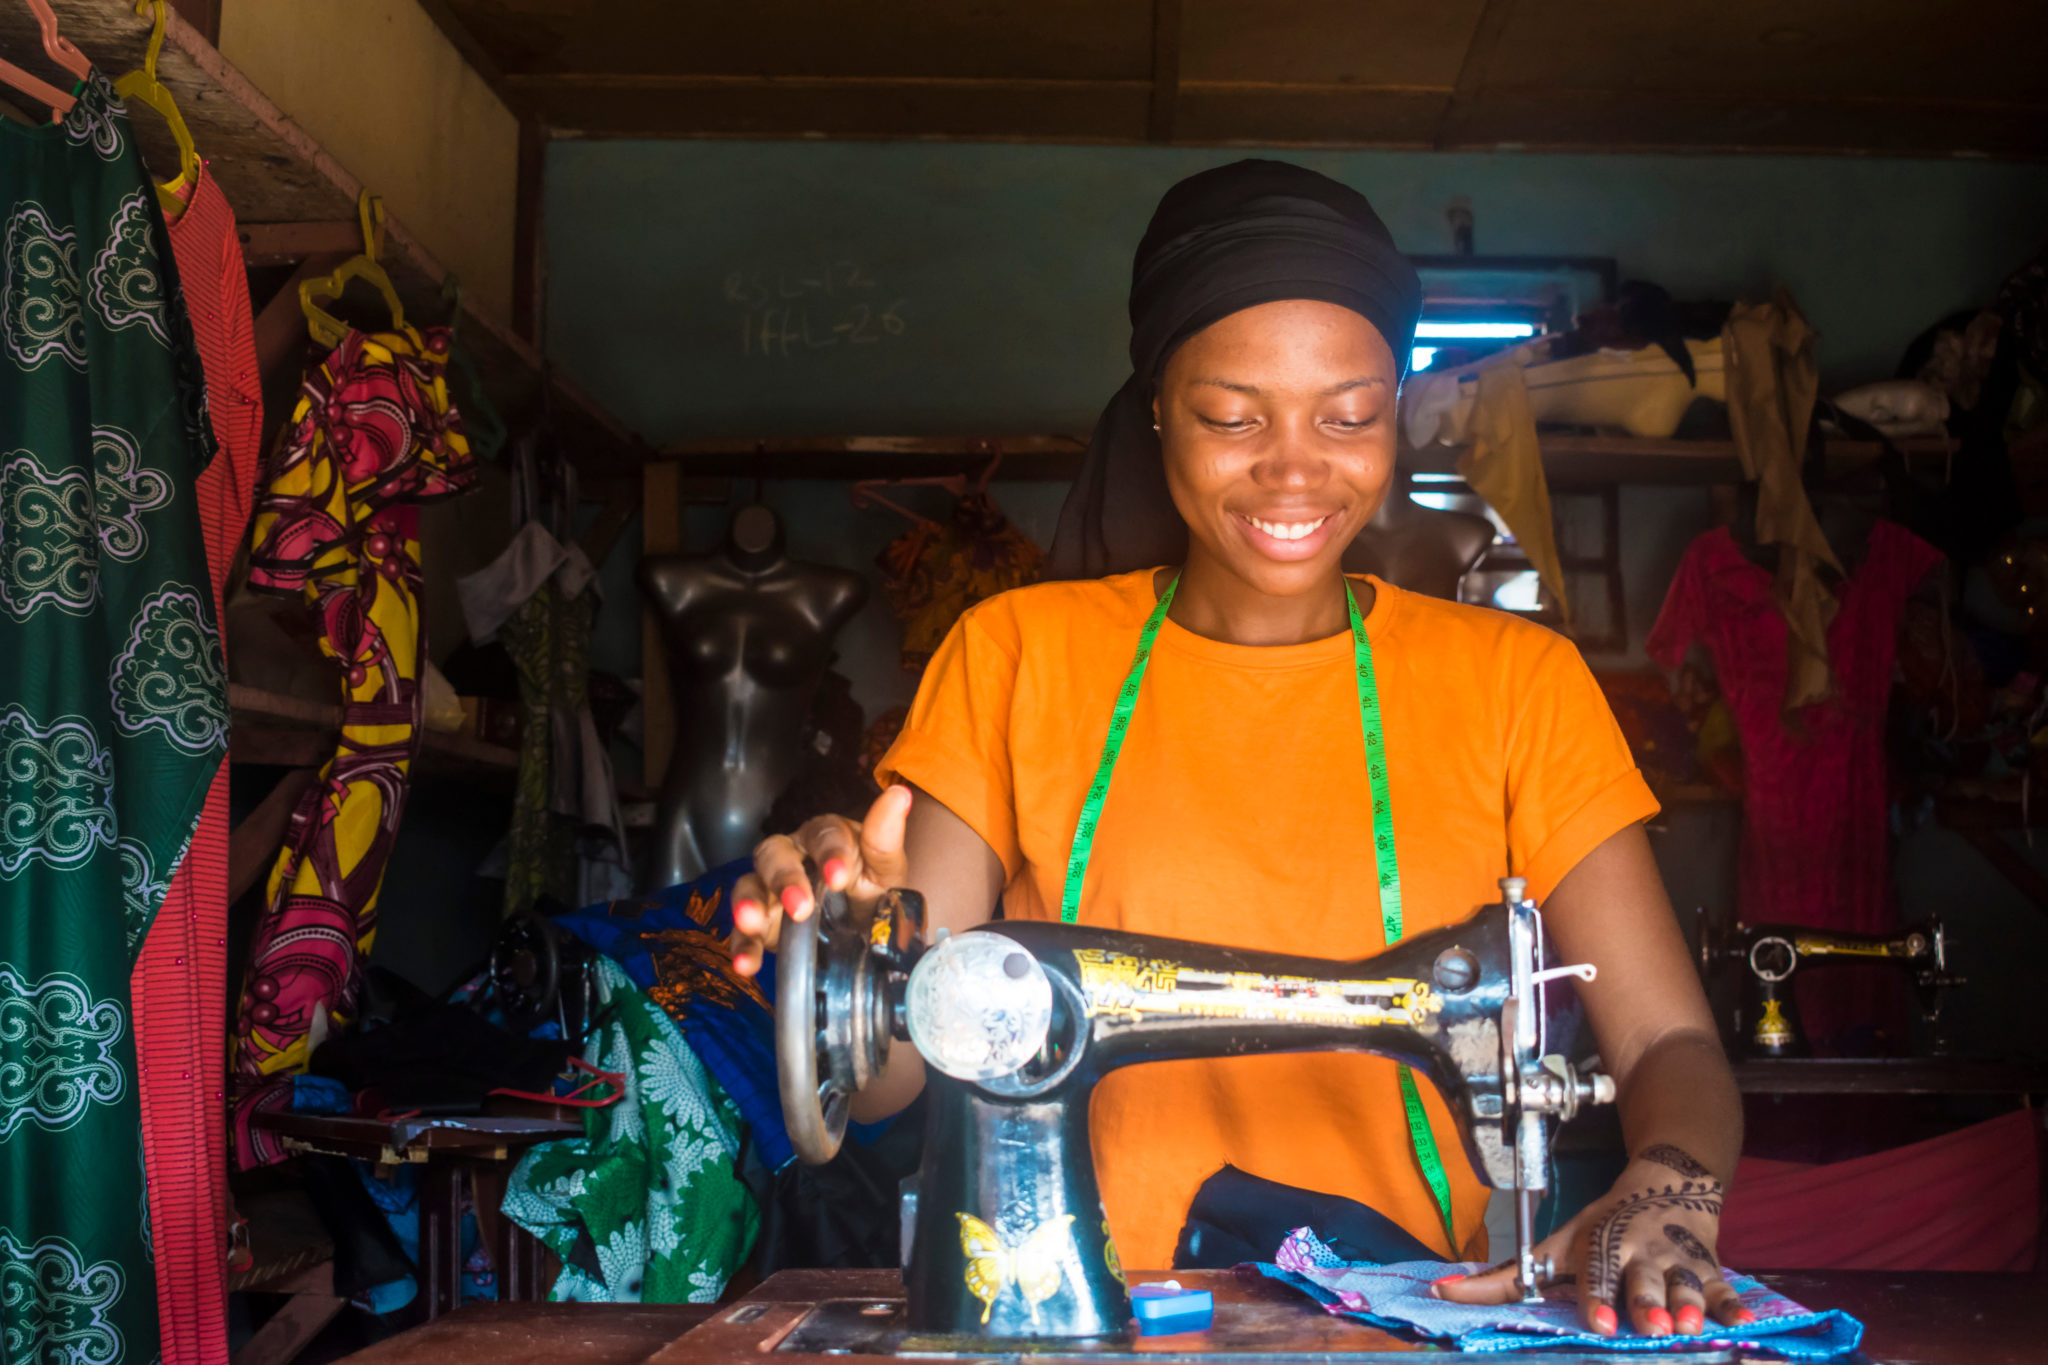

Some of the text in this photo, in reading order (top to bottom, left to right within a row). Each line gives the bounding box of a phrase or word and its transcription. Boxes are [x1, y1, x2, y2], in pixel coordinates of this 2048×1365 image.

[1359, 663, 1369, 678] 40
[1363, 696, 1373, 710] 41
[1367, 731, 1377, 746] 42
[1371, 764, 1381, 780] 43
[1066, 905, 1076, 920] 21
[1072, 861, 1083, 878] 22
[1082, 822, 1093, 838] 23
[1093, 785, 1105, 800] 24
[1104, 750, 1116, 765] 25
[1115, 716, 1127, 731] 26
[1126, 683, 1137, 696] 27
[1375, 799, 1384, 815] 44
[1378, 834, 1388, 850] 45
[1386, 915, 1396, 933] 47
[1407, 1104, 1418, 1114] 131
[1410, 1121, 1423, 1130] 132
[1414, 1137, 1428, 1147] 133
[1418, 1152, 1431, 1162] 134
